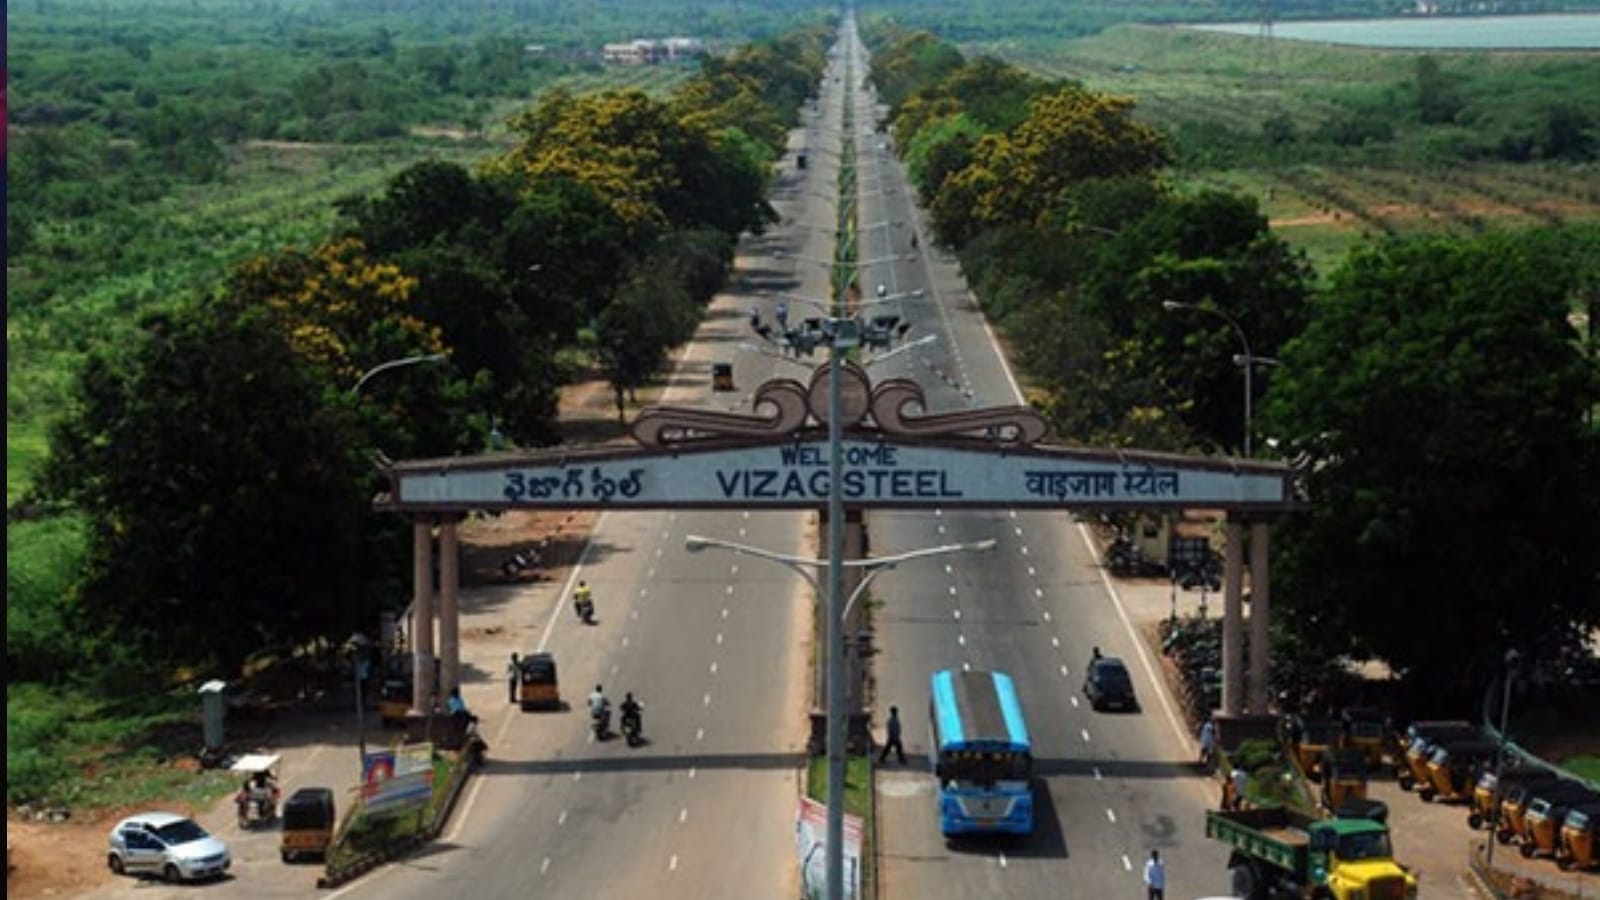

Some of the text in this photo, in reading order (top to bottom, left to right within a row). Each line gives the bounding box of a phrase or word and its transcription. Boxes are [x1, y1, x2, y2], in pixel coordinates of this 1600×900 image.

[781, 446, 897, 466] WELOME
[716, 470, 963, 497] VIZAG STEEL
[1024, 471, 1117, 500] वाइजाग
